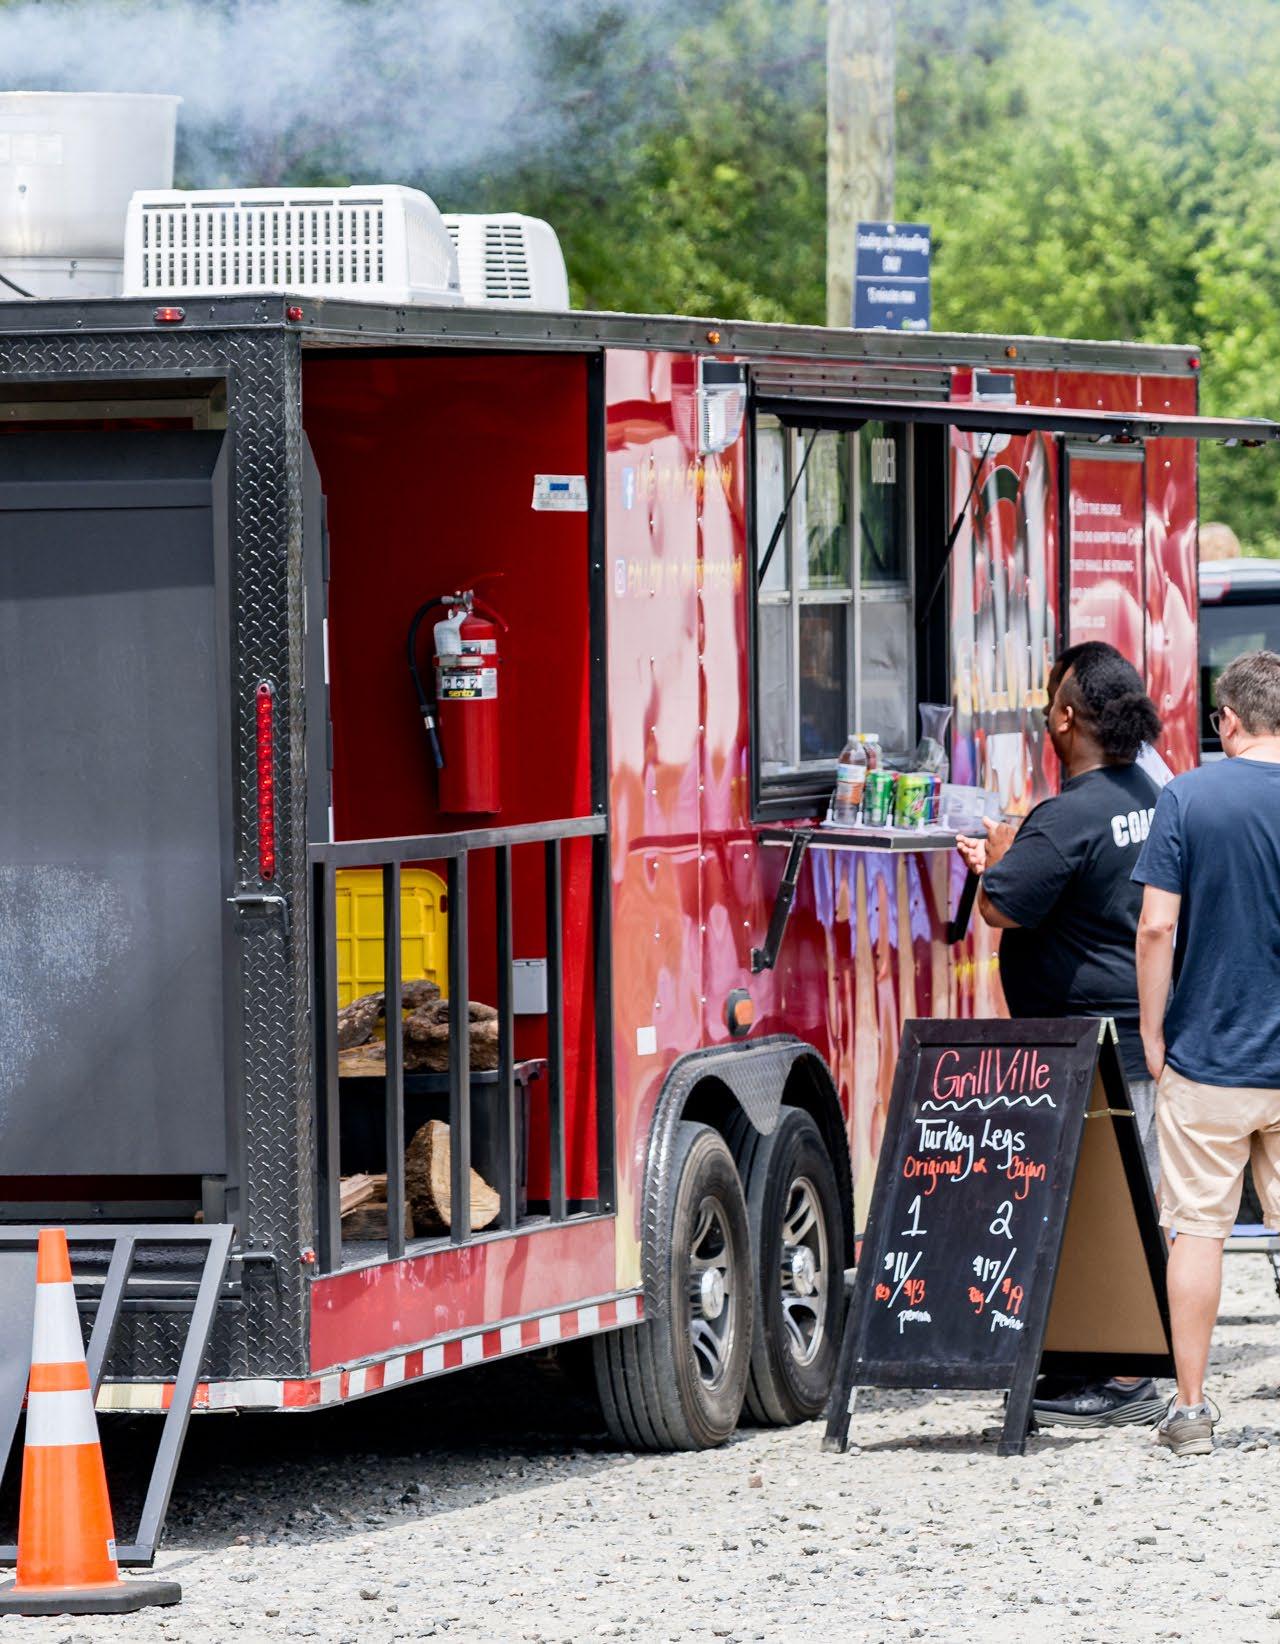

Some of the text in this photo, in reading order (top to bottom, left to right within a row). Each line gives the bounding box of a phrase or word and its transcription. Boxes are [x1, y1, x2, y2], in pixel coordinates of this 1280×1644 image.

[915, 1118, 1026, 1183] Turkey Legs
[903, 1155, 963, 1196] Original
[901, 1195, 927, 1237] 1
[989, 1200, 1014, 1240] 2
